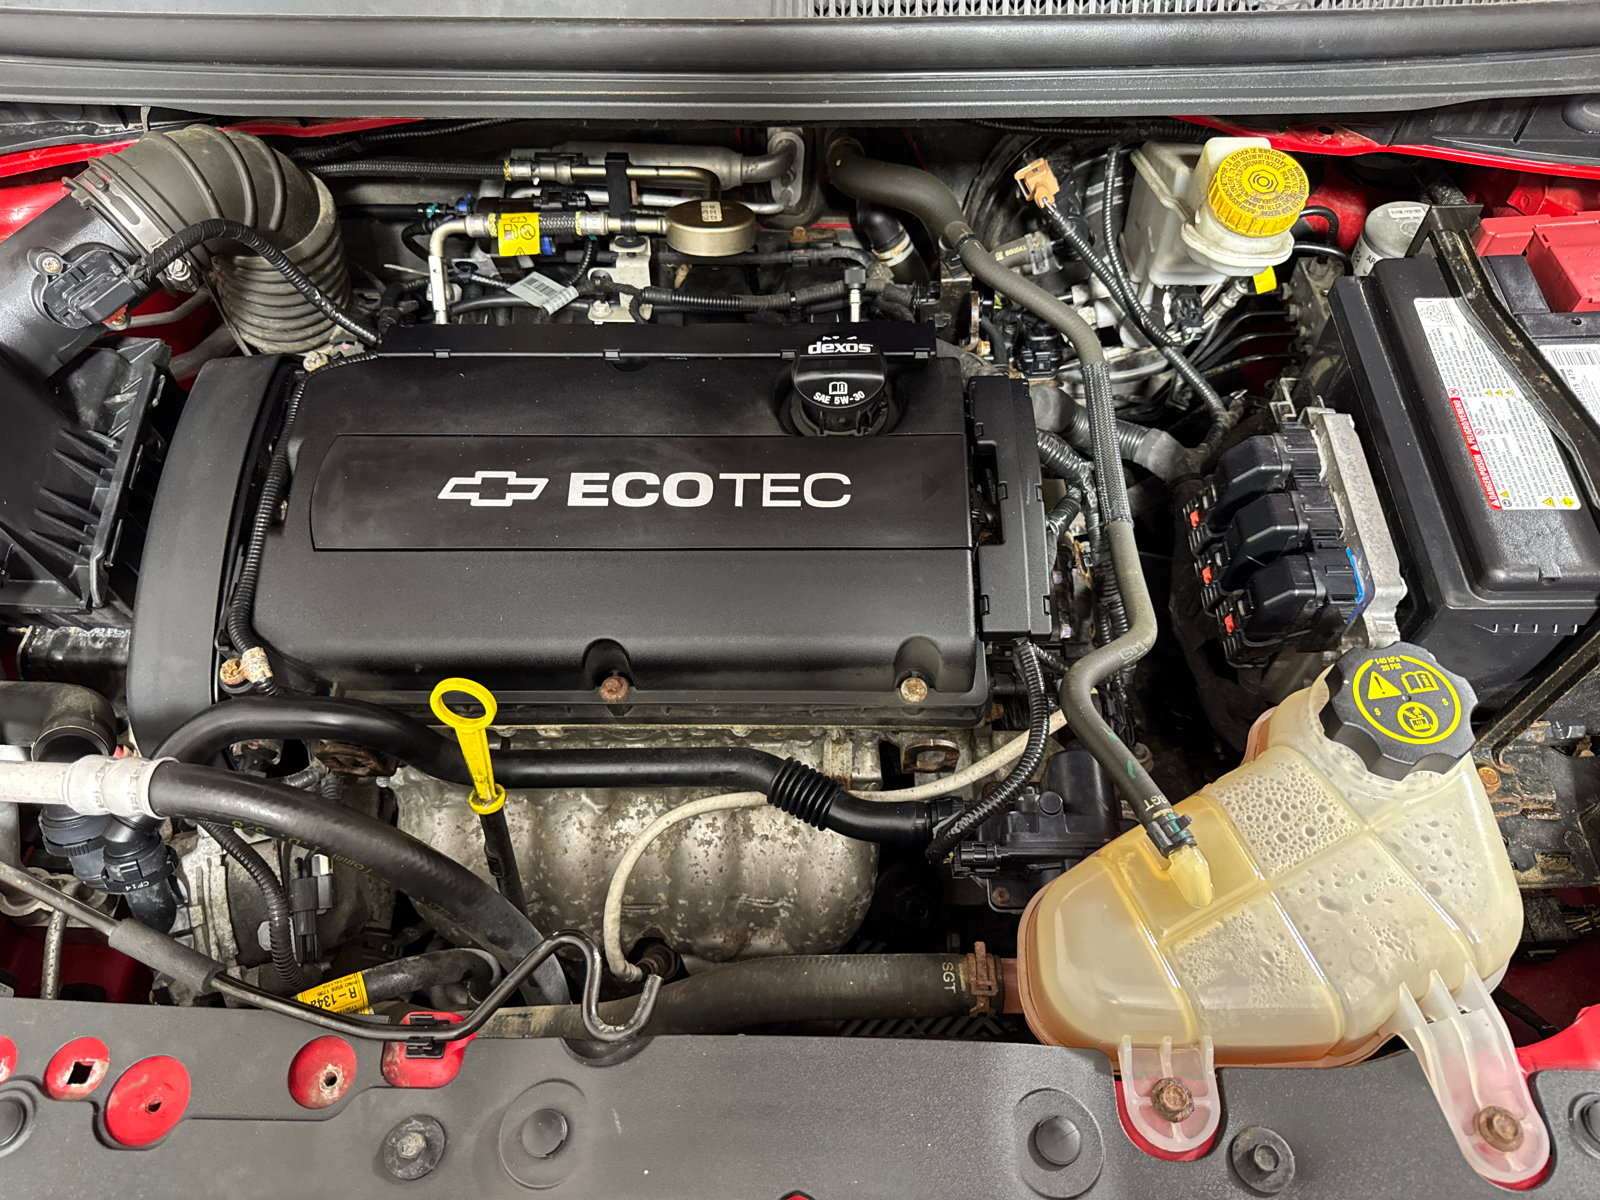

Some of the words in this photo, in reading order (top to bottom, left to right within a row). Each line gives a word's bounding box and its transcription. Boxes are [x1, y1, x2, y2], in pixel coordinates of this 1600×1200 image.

[808, 341, 872, 354] dexos
[813, 392, 831, 404] SAE
[834, 391, 865, 405] 5W-30
[567, 472, 852, 508] ECOTEC
[942, 962, 956, 994] SGT
